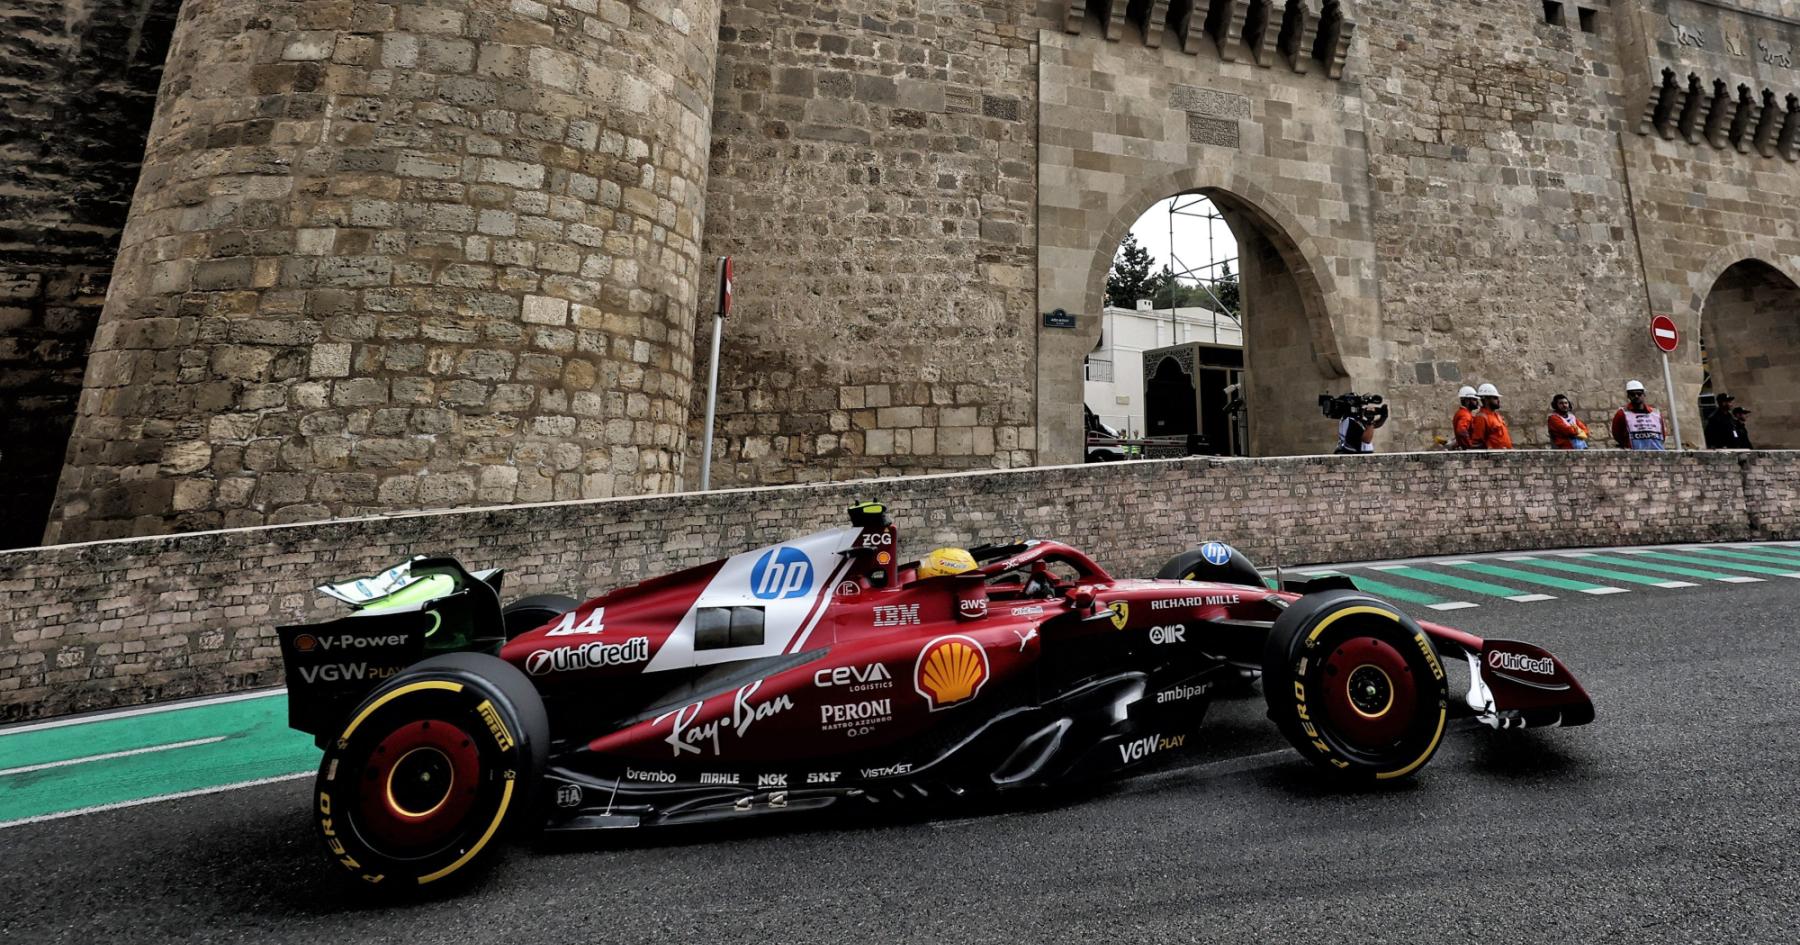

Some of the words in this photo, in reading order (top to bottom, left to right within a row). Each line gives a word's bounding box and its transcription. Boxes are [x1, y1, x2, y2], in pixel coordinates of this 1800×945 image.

[862, 533, 892, 546] ZCG
[1207, 542, 1227, 565] hp
[756, 546, 809, 599] hp
[960, 599, 987, 610] aws
[1151, 596, 1202, 610] RICHARD
[1205, 594, 1240, 605] MILLE
[544, 607, 605, 637] 44
[872, 603, 921, 627] IBM
[318, 633, 409, 650] V-Power
[553, 637, 648, 671] UniCredit
[1414, 632, 1444, 681] PIRELLI
[1502, 652, 1555, 675] UniCredit
[849, 681, 893, 693] LOGISTICS
[1157, 684, 1207, 703] ambipar
[820, 698, 892, 724] PERONI
[1294, 680, 1331, 754] ZERO
[476, 699, 514, 752] PIRELLI
[822, 720, 854, 731] NASTRO
[855, 716, 892, 727] AZZURRO
[626, 767, 677, 783] brembo
[700, 772, 740, 785] MAHLE
[757, 773, 788, 786] NGK
[806, 771, 842, 784] SKF
[557, 787, 580, 805] FIA
[320, 791, 361, 871] ZERO
